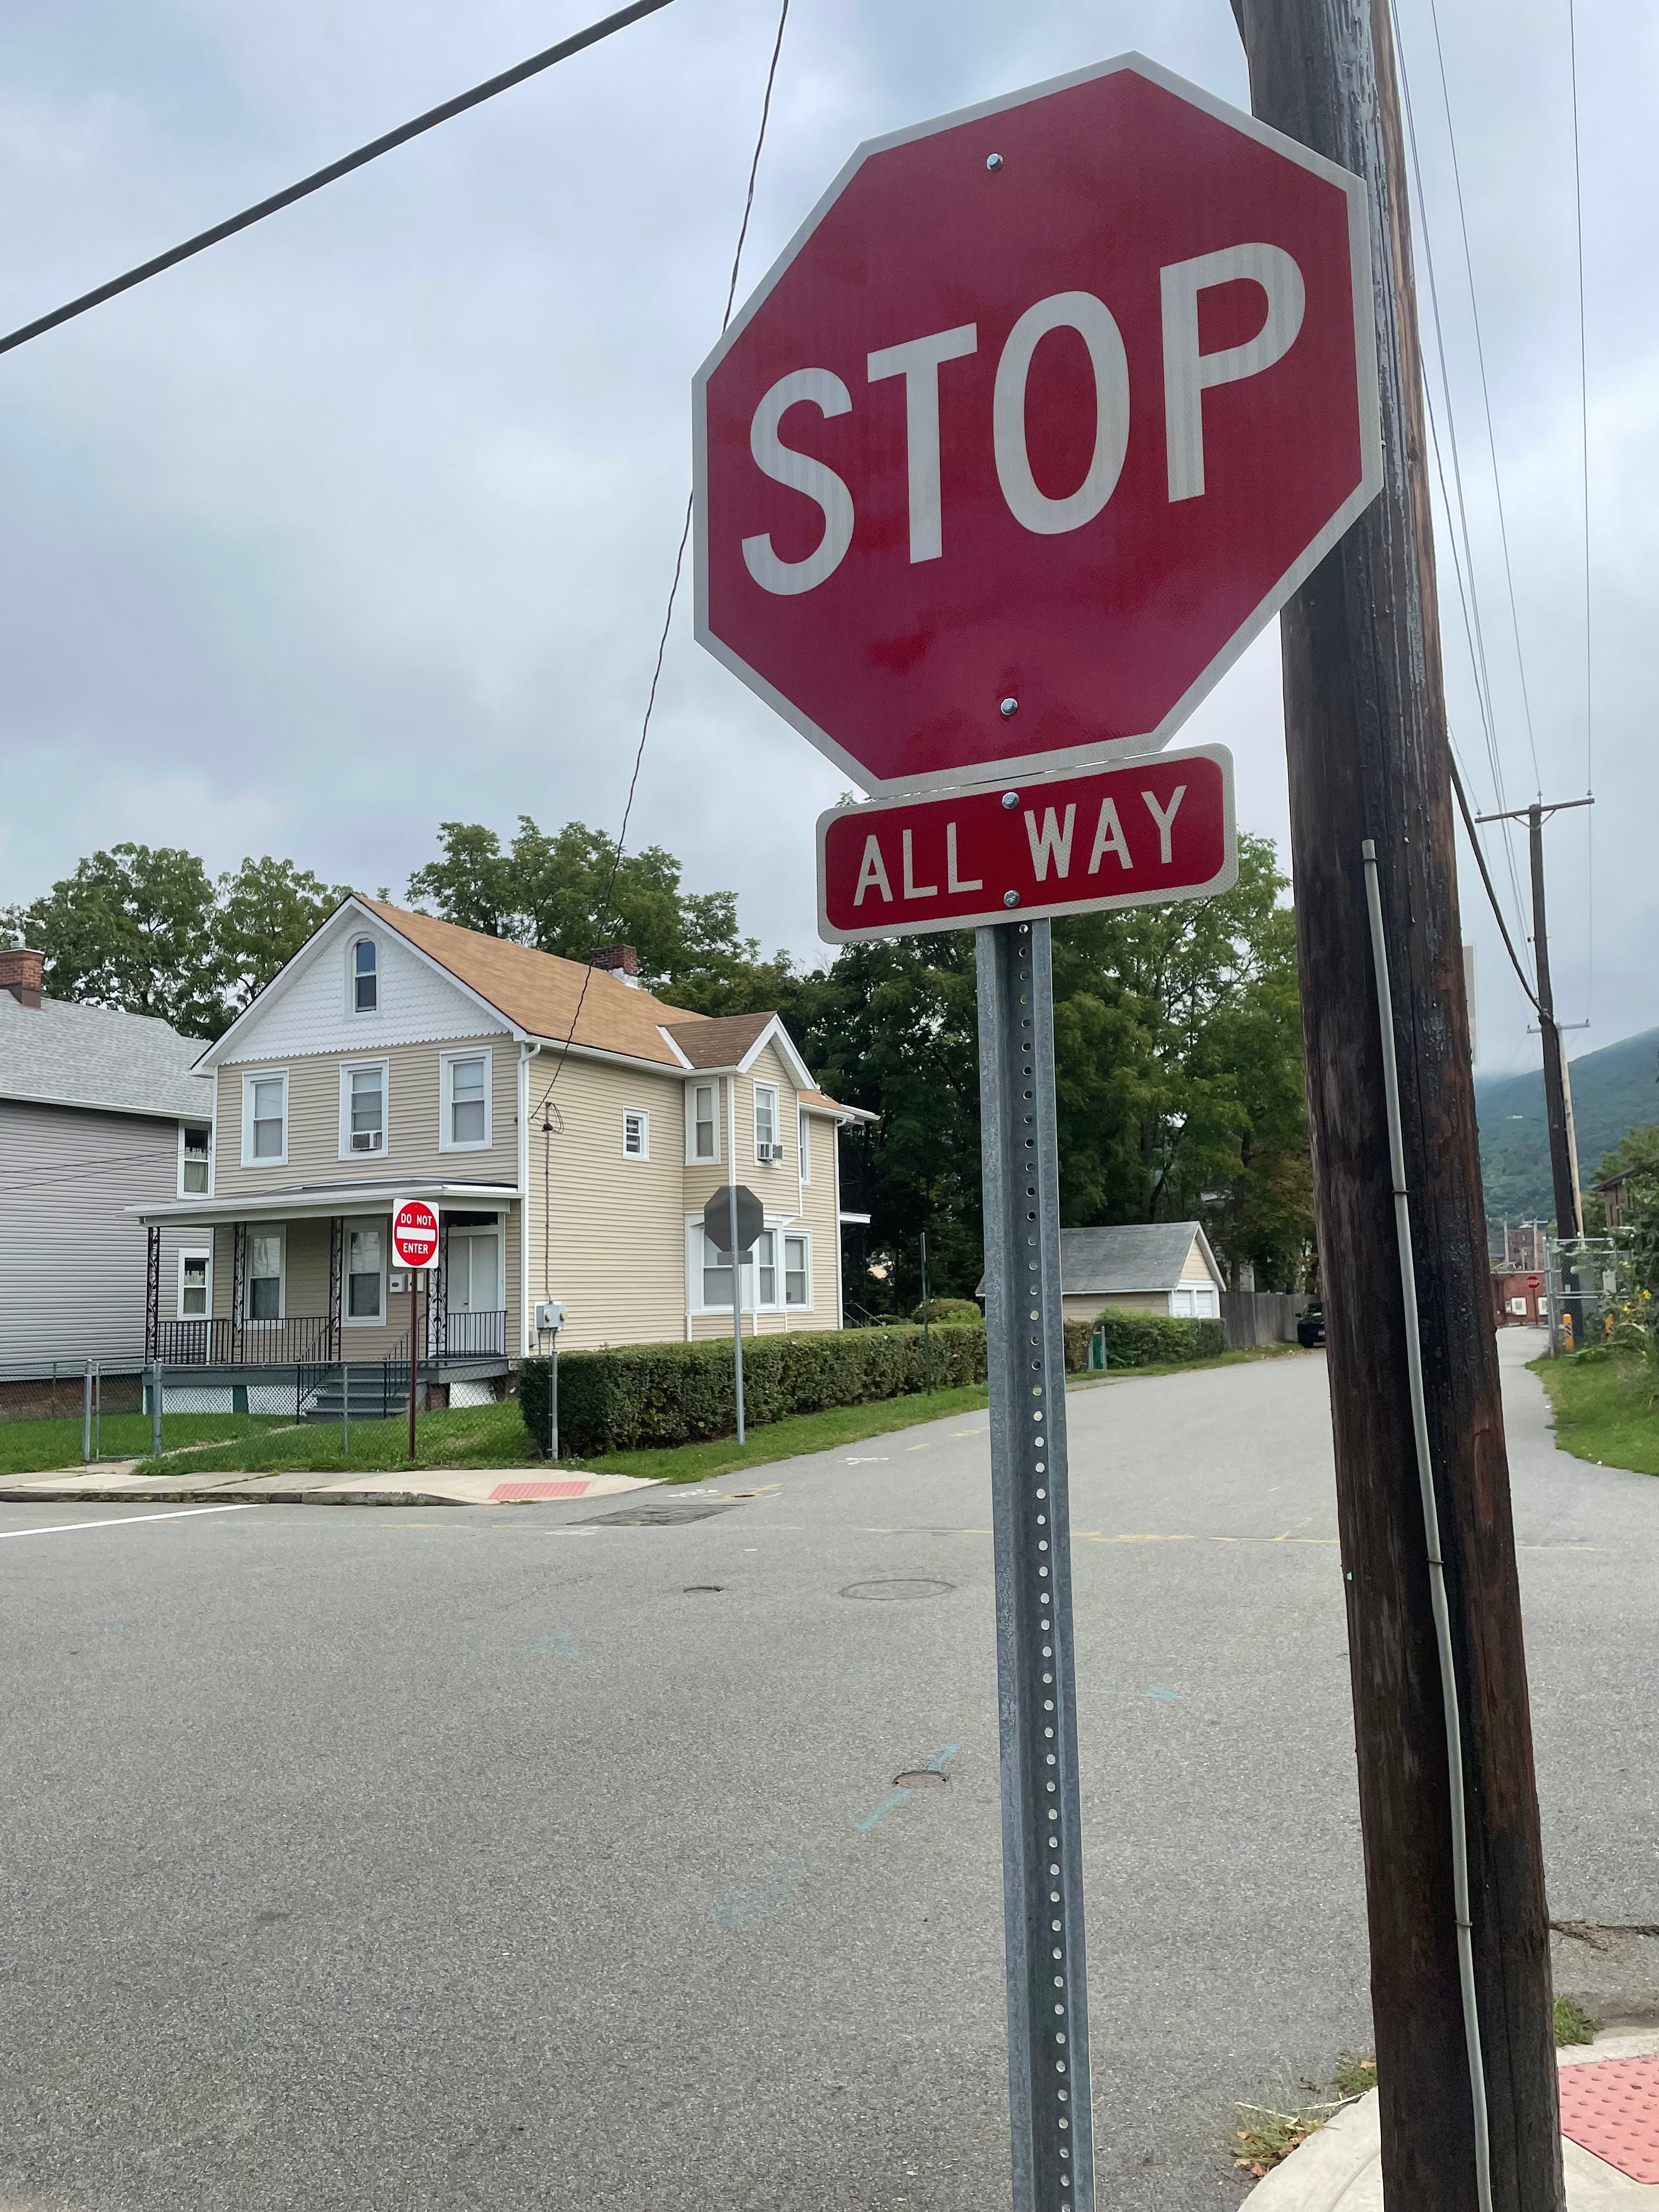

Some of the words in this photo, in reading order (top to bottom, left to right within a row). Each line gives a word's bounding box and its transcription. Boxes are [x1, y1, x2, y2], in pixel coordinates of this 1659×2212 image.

[741, 242, 1306, 596] STOP
[853, 822, 983, 907] ALL
[1024, 785, 1187, 882] WAY
[401, 1213, 411, 1224] DO
[416, 1214, 432, 1226] NOT
[403, 1242, 428, 1255] ENTER
